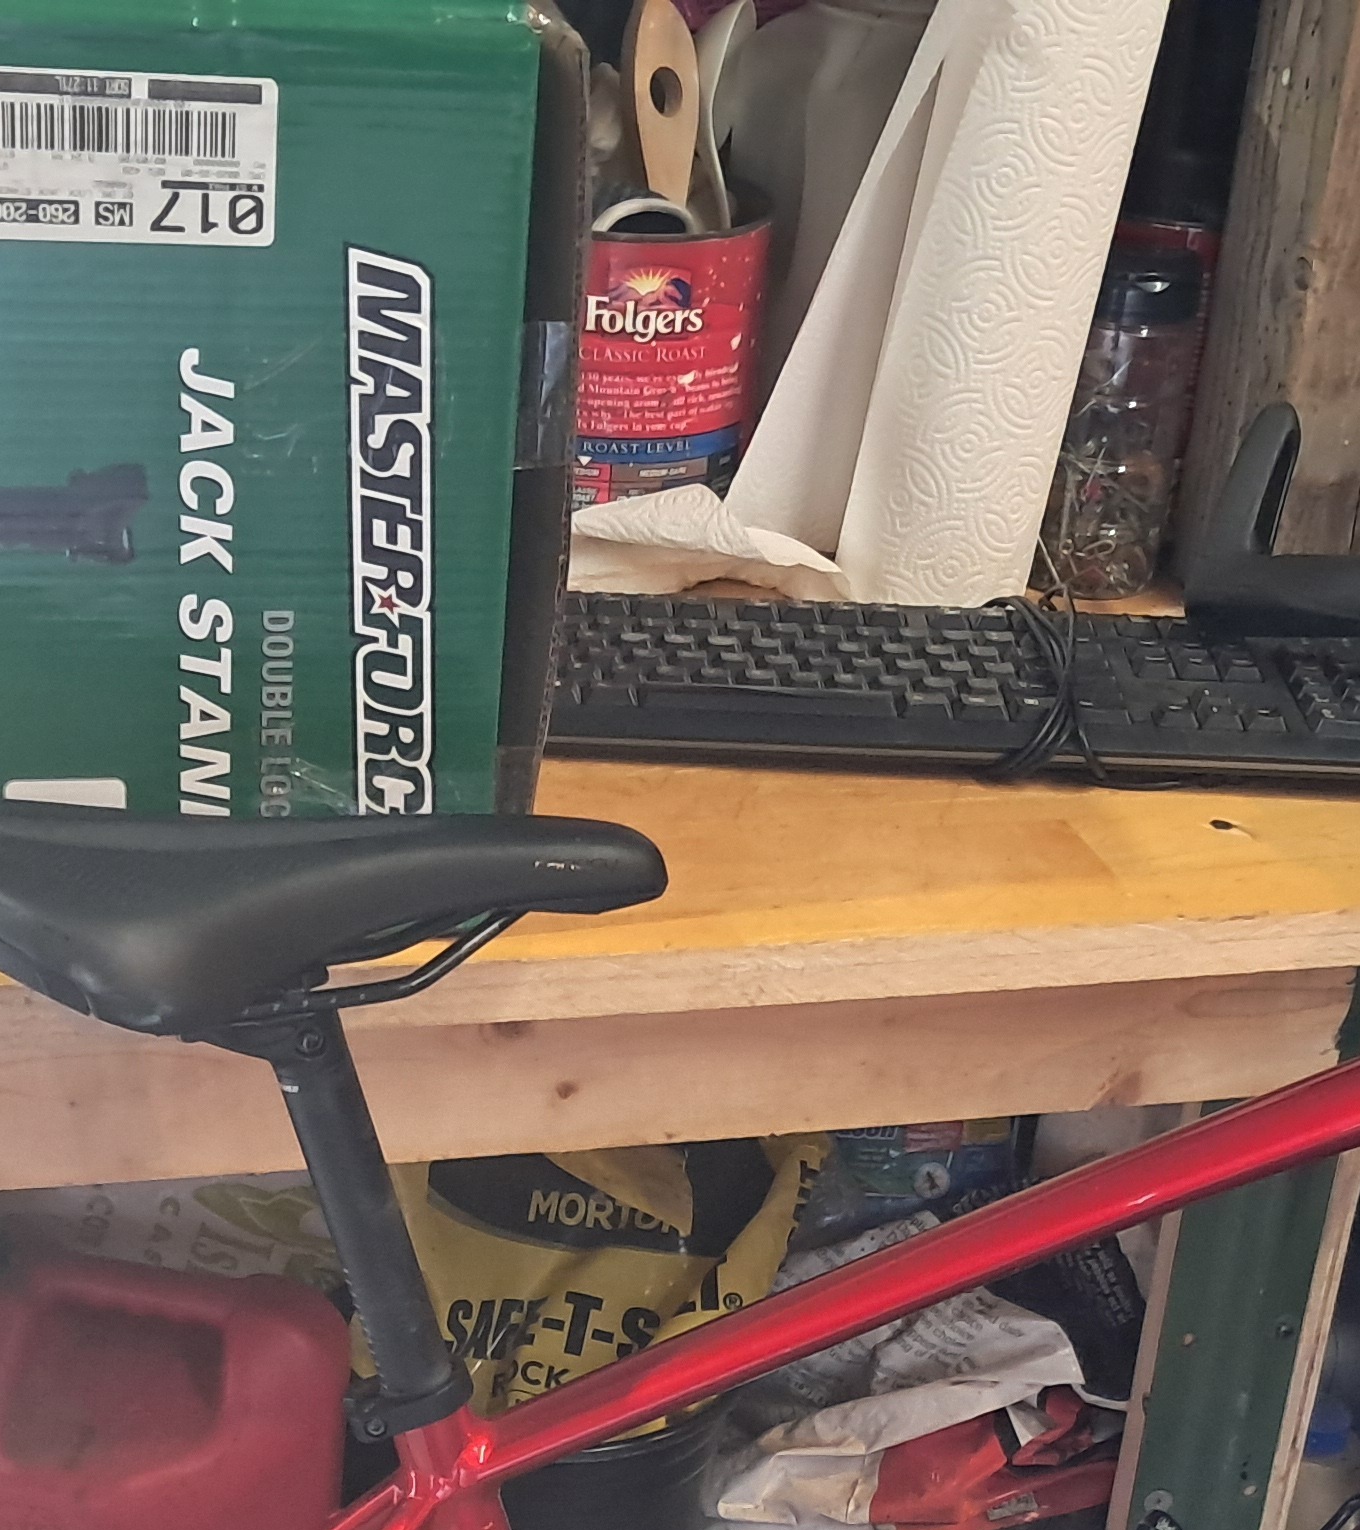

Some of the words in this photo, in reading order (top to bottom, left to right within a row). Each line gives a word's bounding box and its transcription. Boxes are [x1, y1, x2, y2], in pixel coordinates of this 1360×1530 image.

[98, 203, 131, 225] MS
[149, 191, 264, 236] 017
[585, 294, 704, 344] Folgers
[178, 348, 235, 574] JACK
[583, 441, 640, 455] ROAST
[646, 439, 690, 455] LEVEL
[345, 246, 436, 816] MASTERFORC
[178, 593, 235, 818] STAN
[259, 610, 295, 747] DOUBLE
[259, 757, 293, 818] LOC
